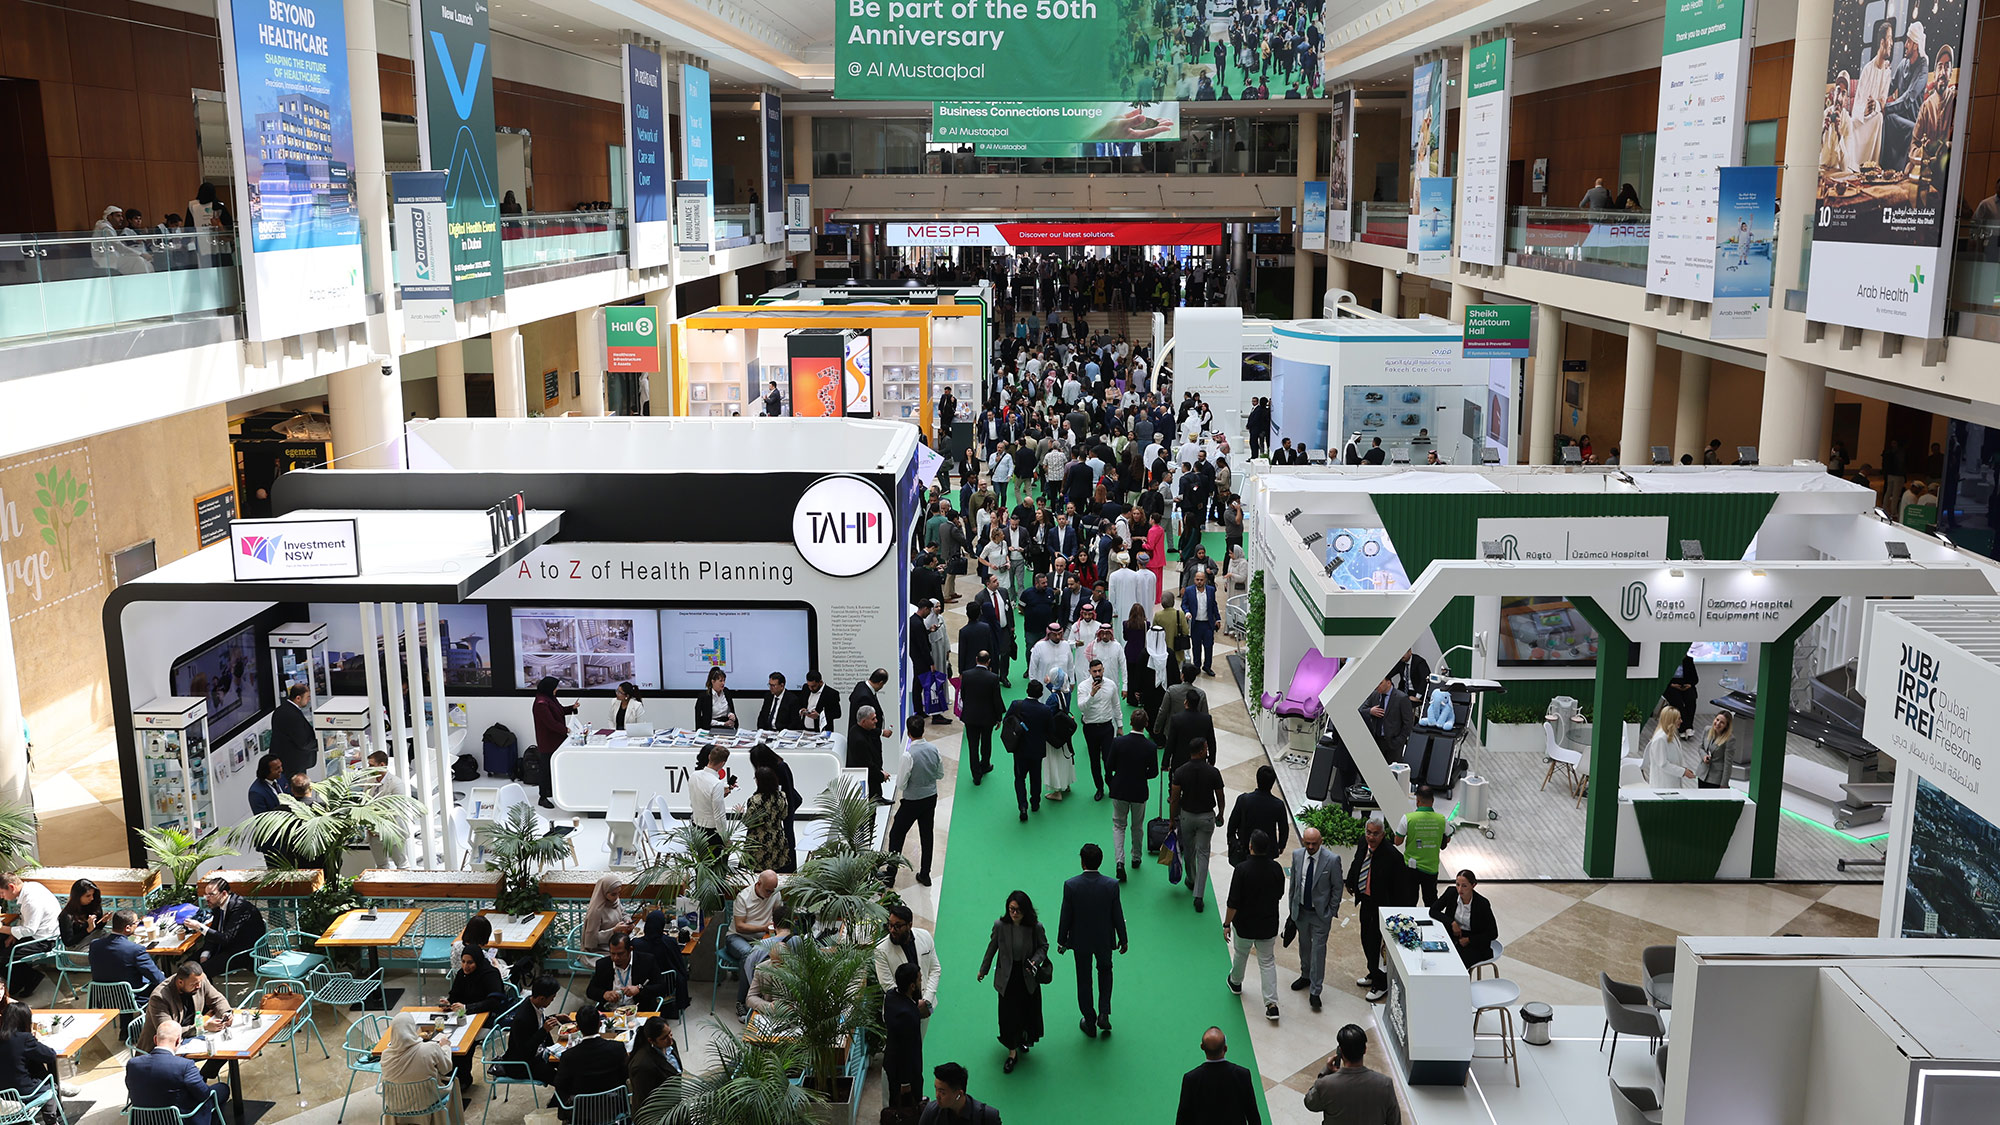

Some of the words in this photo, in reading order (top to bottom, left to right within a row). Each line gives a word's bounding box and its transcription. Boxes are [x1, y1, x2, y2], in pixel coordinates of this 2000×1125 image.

[269, 0, 315, 28] BEYOND
[442, 5, 454, 21] New
[455, 9, 474, 26] Launch
[850, 0, 880, 17] Be
[888, 0, 944, 22] part
[951, 0, 977, 18] of
[985, 0, 1028, 19] the
[1036, 0, 1097, 19] 50th
[1681, 2, 1691, 12] Arab
[259, 24, 329, 57] HEALTHCARE
[848, 24, 1005, 51] Anniversary
[1675, 32, 1688, 42] Thank
[1687, 31, 1696, 40] you
[1707, 22, 1727, 35] partners
[265, 53, 293, 67] SHAPING
[293, 58, 305, 70] THE
[305, 60, 327, 73] FUTURE
[848, 62, 862, 77] @
[866, 62, 883, 77] Al
[888, 62, 985, 81] Mustaqbal
[274, 67, 283, 78] OF
[284, 68, 321, 84] HEALTHCARE
[636, 104, 649, 119] Global
[939, 106, 988, 117] Business
[990, 106, 1060, 117] Connections
[1062, 106, 1103, 119] Lounge
[637, 127, 654, 142] Network
[939, 127, 947, 135] @
[949, 127, 958, 135] Al
[959, 127, 1009, 138] Mustaqbal
[638, 149, 647, 164] Care
[647, 151, 655, 164] and
[993, 144, 1027, 152] Mustaqbal
[639, 172, 650, 186] Cover
[685, 206, 693, 240] AMBULANCE
[1818, 206, 1831, 227] 10
[449, 222, 466, 239] Digital
[466, 221, 482, 234] Health
[482, 220, 496, 233] Event
[907, 225, 980, 238] MESPA
[412, 209, 430, 280] Paramed
[462, 238, 467, 250] in
[467, 237, 482, 250] Dubai
[1857, 284, 1878, 299] Arab
[1879, 286, 1909, 302] Health
[1469, 310, 1498, 318] Sheikh
[611, 321, 634, 332] Hall
[1468, 319, 1511, 327] Maktoum
[1468, 327, 1485, 335] Hall
[284, 448, 317, 458] egemen
[806, 511, 883, 544] TAHPI
[283, 540, 346, 550] Investment
[285, 551, 314, 561] NSW
[1572, 550, 1609, 559] Üzümcü
[1611, 550, 1649, 559] Hospital
[518, 560, 532, 579] A
[540, 561, 559, 579] to
[569, 560, 582, 579] Z
[591, 560, 612, 579] of
[621, 560, 690, 580] Health
[699, 560, 794, 585] Planning
[1656, 599, 1685, 610] Rüştü
[1707, 598, 1747, 609] Üzümcü
[1750, 599, 1793, 610] Hospital
[1655, 610, 1696, 620] Üzümcü
[1706, 611, 1759, 622] Equipment
[1761, 611, 1780, 620] INC
[1938, 690, 1969, 723] Dubai
[1936, 711, 1971, 745] Airport
[1891, 733, 1907, 749] دبي
[1934, 727, 1982, 771] Freezone
[1909, 741, 1928, 765] بمطار
[1929, 752, 1947, 774] الحرة
[1947, 764, 1979, 795] المنطقة
